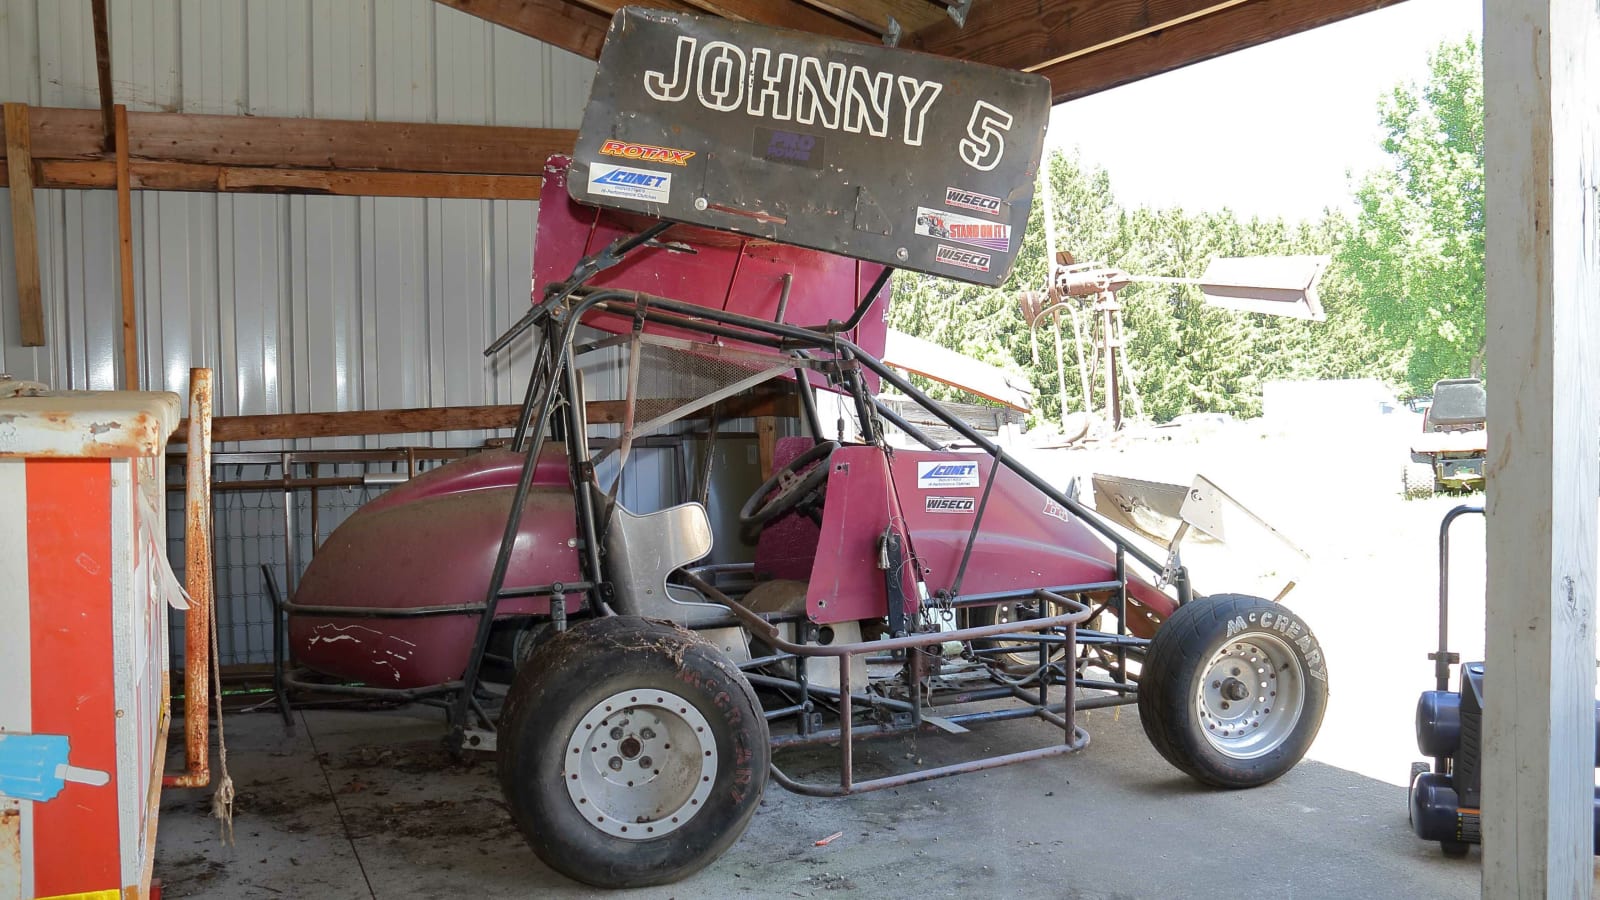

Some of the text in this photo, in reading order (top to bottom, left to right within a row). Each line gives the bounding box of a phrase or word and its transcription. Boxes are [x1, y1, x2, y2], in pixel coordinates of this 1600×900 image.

[643, 36, 1014, 172] JOHNNY 5
[599, 139, 695, 166] ROTAX
[947, 191, 999, 209] WISECO
[950, 224, 1007, 239] STAND ON IT!
[938, 248, 989, 266] WISECO
[926, 499, 974, 510] WISECO
[1226, 611, 1327, 682] McCREARY
